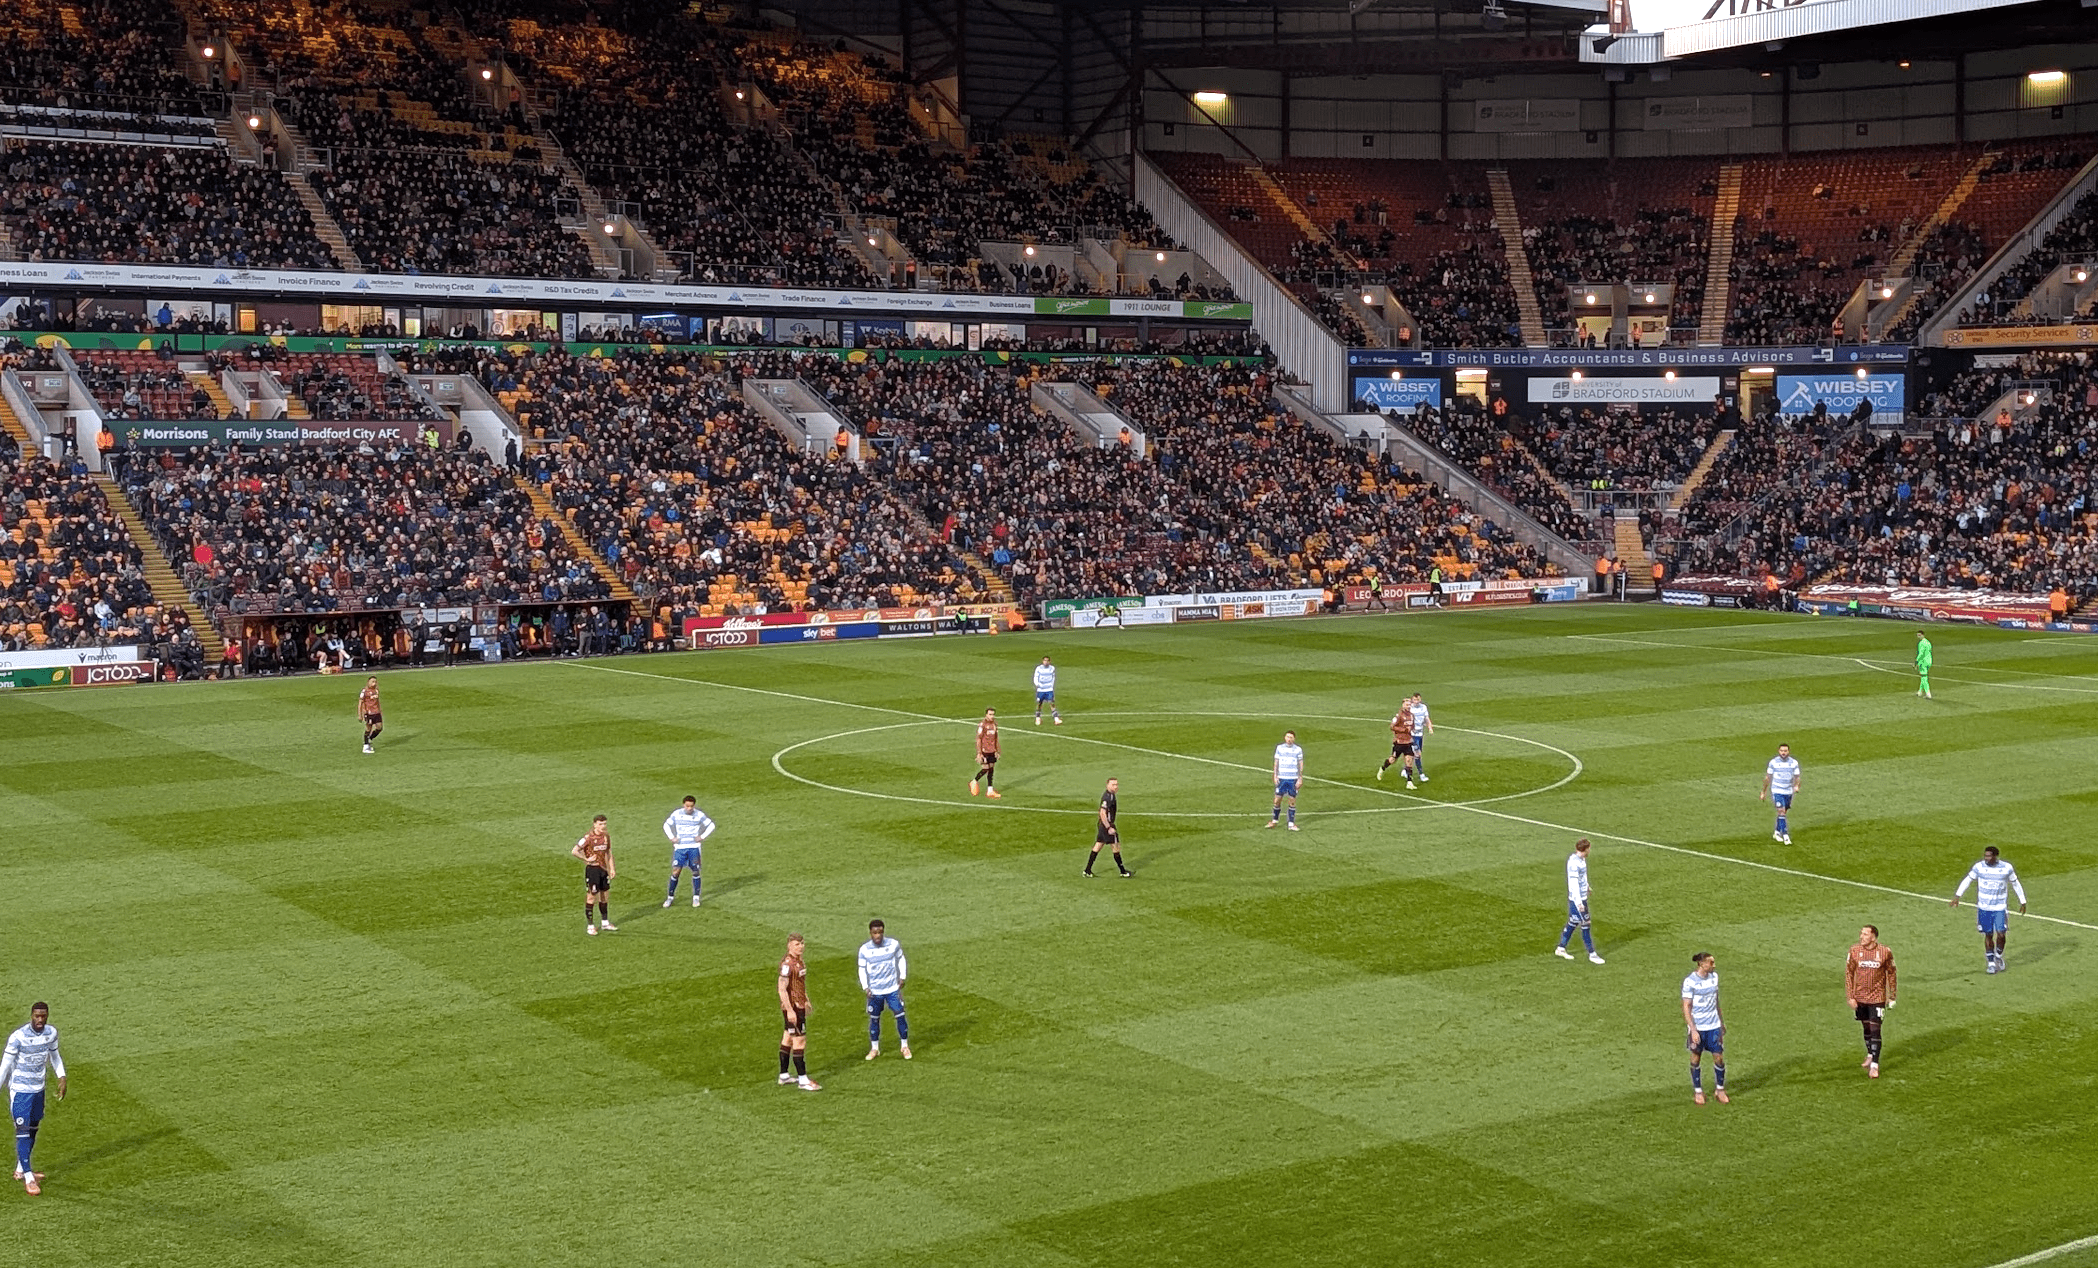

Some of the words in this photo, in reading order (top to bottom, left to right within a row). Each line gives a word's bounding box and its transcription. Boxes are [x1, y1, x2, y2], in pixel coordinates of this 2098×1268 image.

[22, 269, 48, 279] Loans
[131, 273, 171, 281] International
[172, 274, 202, 282] Payments
[278, 277, 308, 285] Invoice
[309, 278, 341, 286] Finance
[414, 282, 450, 291] Revolving
[452, 283, 475, 291] Credit
[573, 287, 599, 295] Credits
[781, 294, 800, 302] Trade
[887, 298, 907, 306] Foreign
[1124, 303, 1138, 311] 1911
[1141, 303, 1171, 312] LOUNGE
[662, 319, 681, 327] RMA
[1995, 329, 2030, 339] Security
[2032, 328, 2069, 337] Services
[1447, 353, 1487, 364] Smith
[1493, 353, 1536, 364] Butler
[1542, 353, 1635, 364] Accountants
[1642, 352, 1652, 363] &
[1659, 352, 1725, 363] Business
[1731, 351, 1794, 364] Advisors
[1379, 382, 1437, 392] WIBSEY
[1814, 380, 1898, 394] WIBSEY
[1386, 394, 1430, 402] ROOFING
[1573, 389, 1639, 398] BRADFORD
[1642, 389, 1695, 398] STADIUM
[1825, 396, 1888, 407] ROOFNG
[143, 426, 209, 440] Morrisons
[226, 427, 263, 442] Family
[265, 427, 299, 439] Stand
[301, 427, 351, 439] Bradford
[353, 427, 376, 442] City
[378, 428, 400, 439] AFC
[1354, 588, 1403, 600] LEOARDO
[1048, 603, 1076, 614] JAMESON
[1245, 604, 1264, 613] ASK
[889, 622, 932, 631] WALTONS
[803, 628, 819, 639] sky
[820, 628, 836, 637] bet
